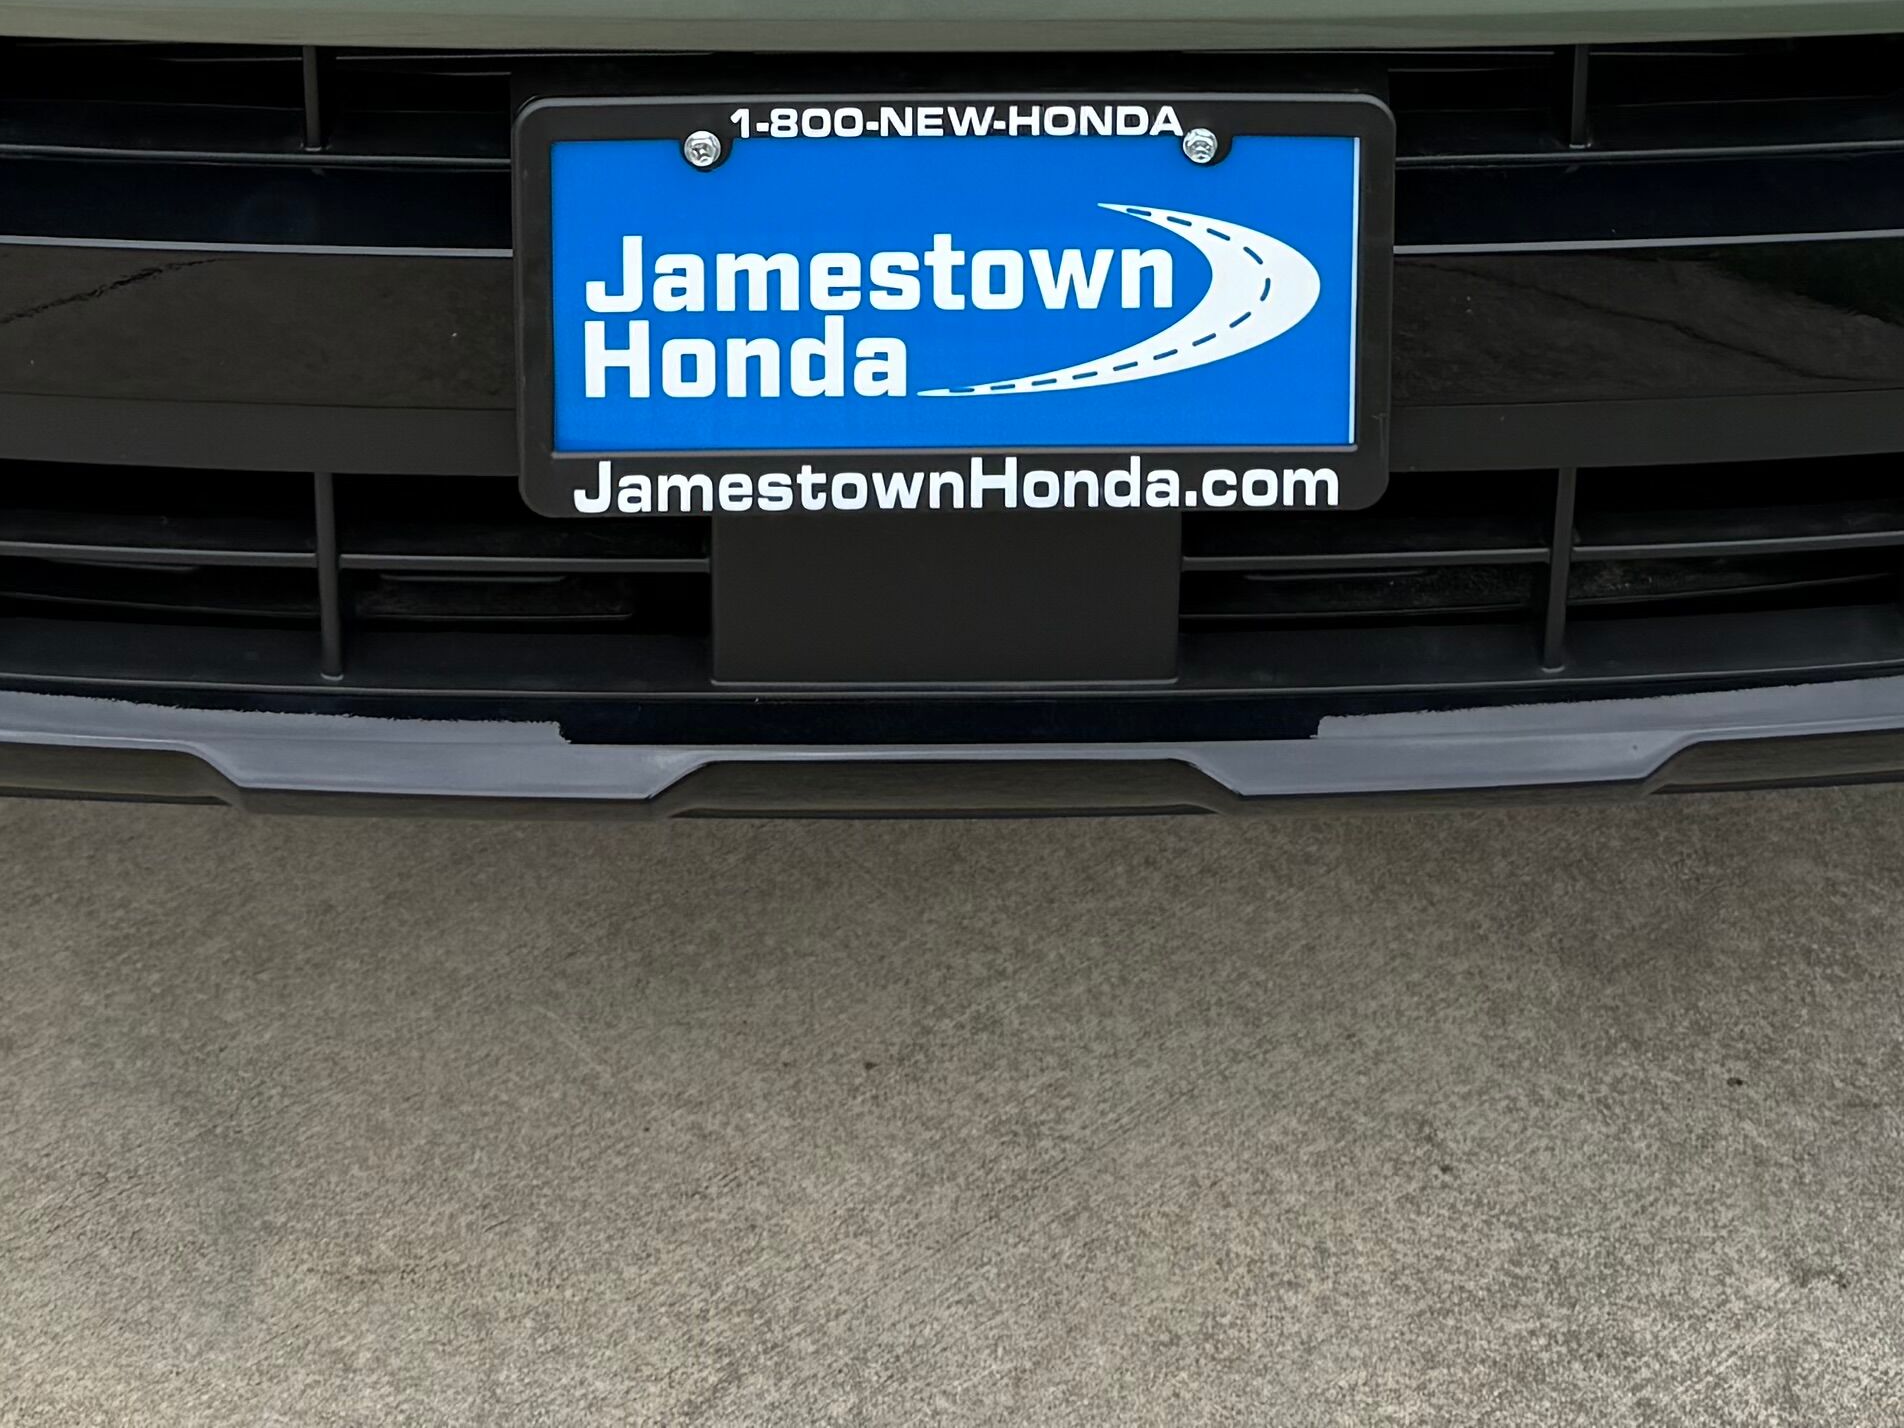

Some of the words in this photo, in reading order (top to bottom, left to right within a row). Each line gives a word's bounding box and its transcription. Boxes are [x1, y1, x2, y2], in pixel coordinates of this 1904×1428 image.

[730, 105, 1184, 139] 1-800-NEW-HONDA
[585, 233, 1174, 313] Jamestown
[584, 315, 908, 399] Honda
[572, 455, 1340, 514] JamestownHonda.com
